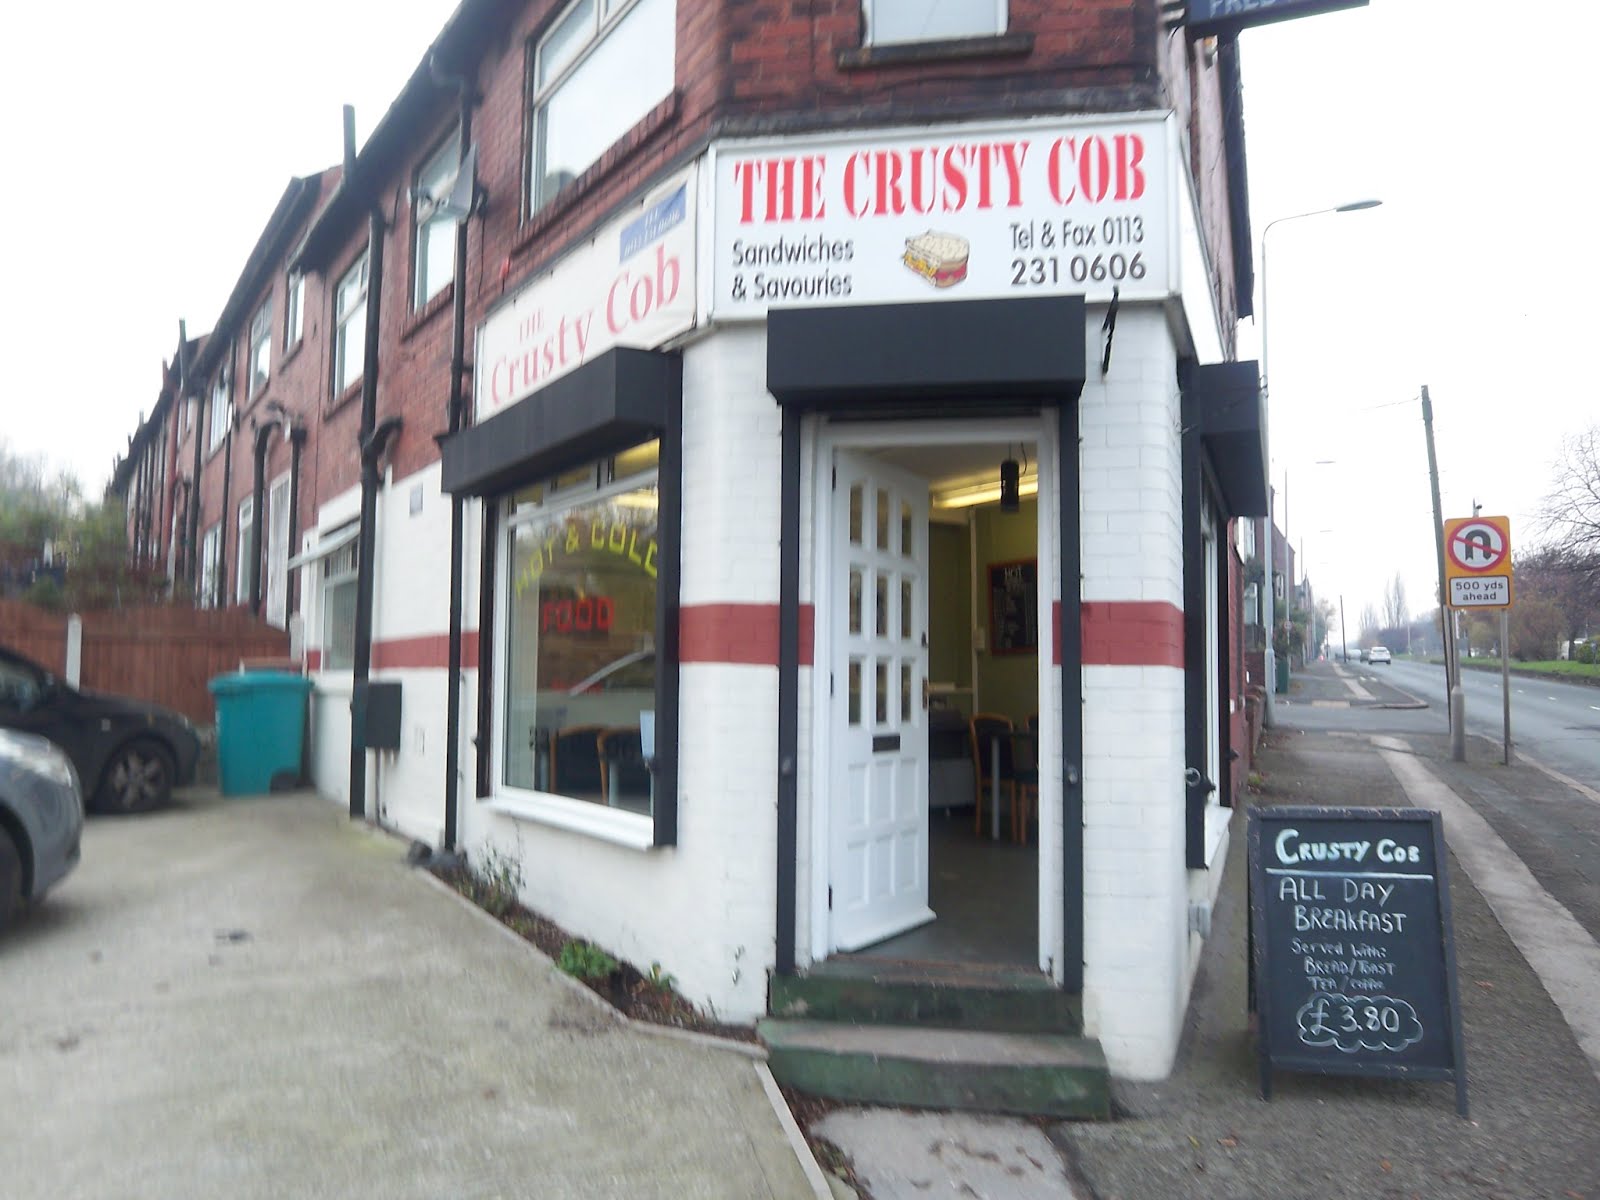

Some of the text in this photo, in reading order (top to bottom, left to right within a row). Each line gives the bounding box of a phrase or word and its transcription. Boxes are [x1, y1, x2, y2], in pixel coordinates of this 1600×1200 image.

[734, 132, 1147, 226] THE CRUSTY COB
[731, 232, 855, 267] Sandwiches
[1009, 215, 1145, 252] Tel & Fax 0113
[731, 267, 853, 299] & Savouries
[1010, 251, 1147, 286] 231 0606
[491, 242, 681, 406] Crusty Cob
[1455, 581, 1504, 591] 500 yds
[1462, 592, 1497, 601] ahead
[543, 596, 615, 633] FOOD
[1274, 828, 1371, 865] CRUSTY
[1279, 876, 1395, 907] ALL DAY
